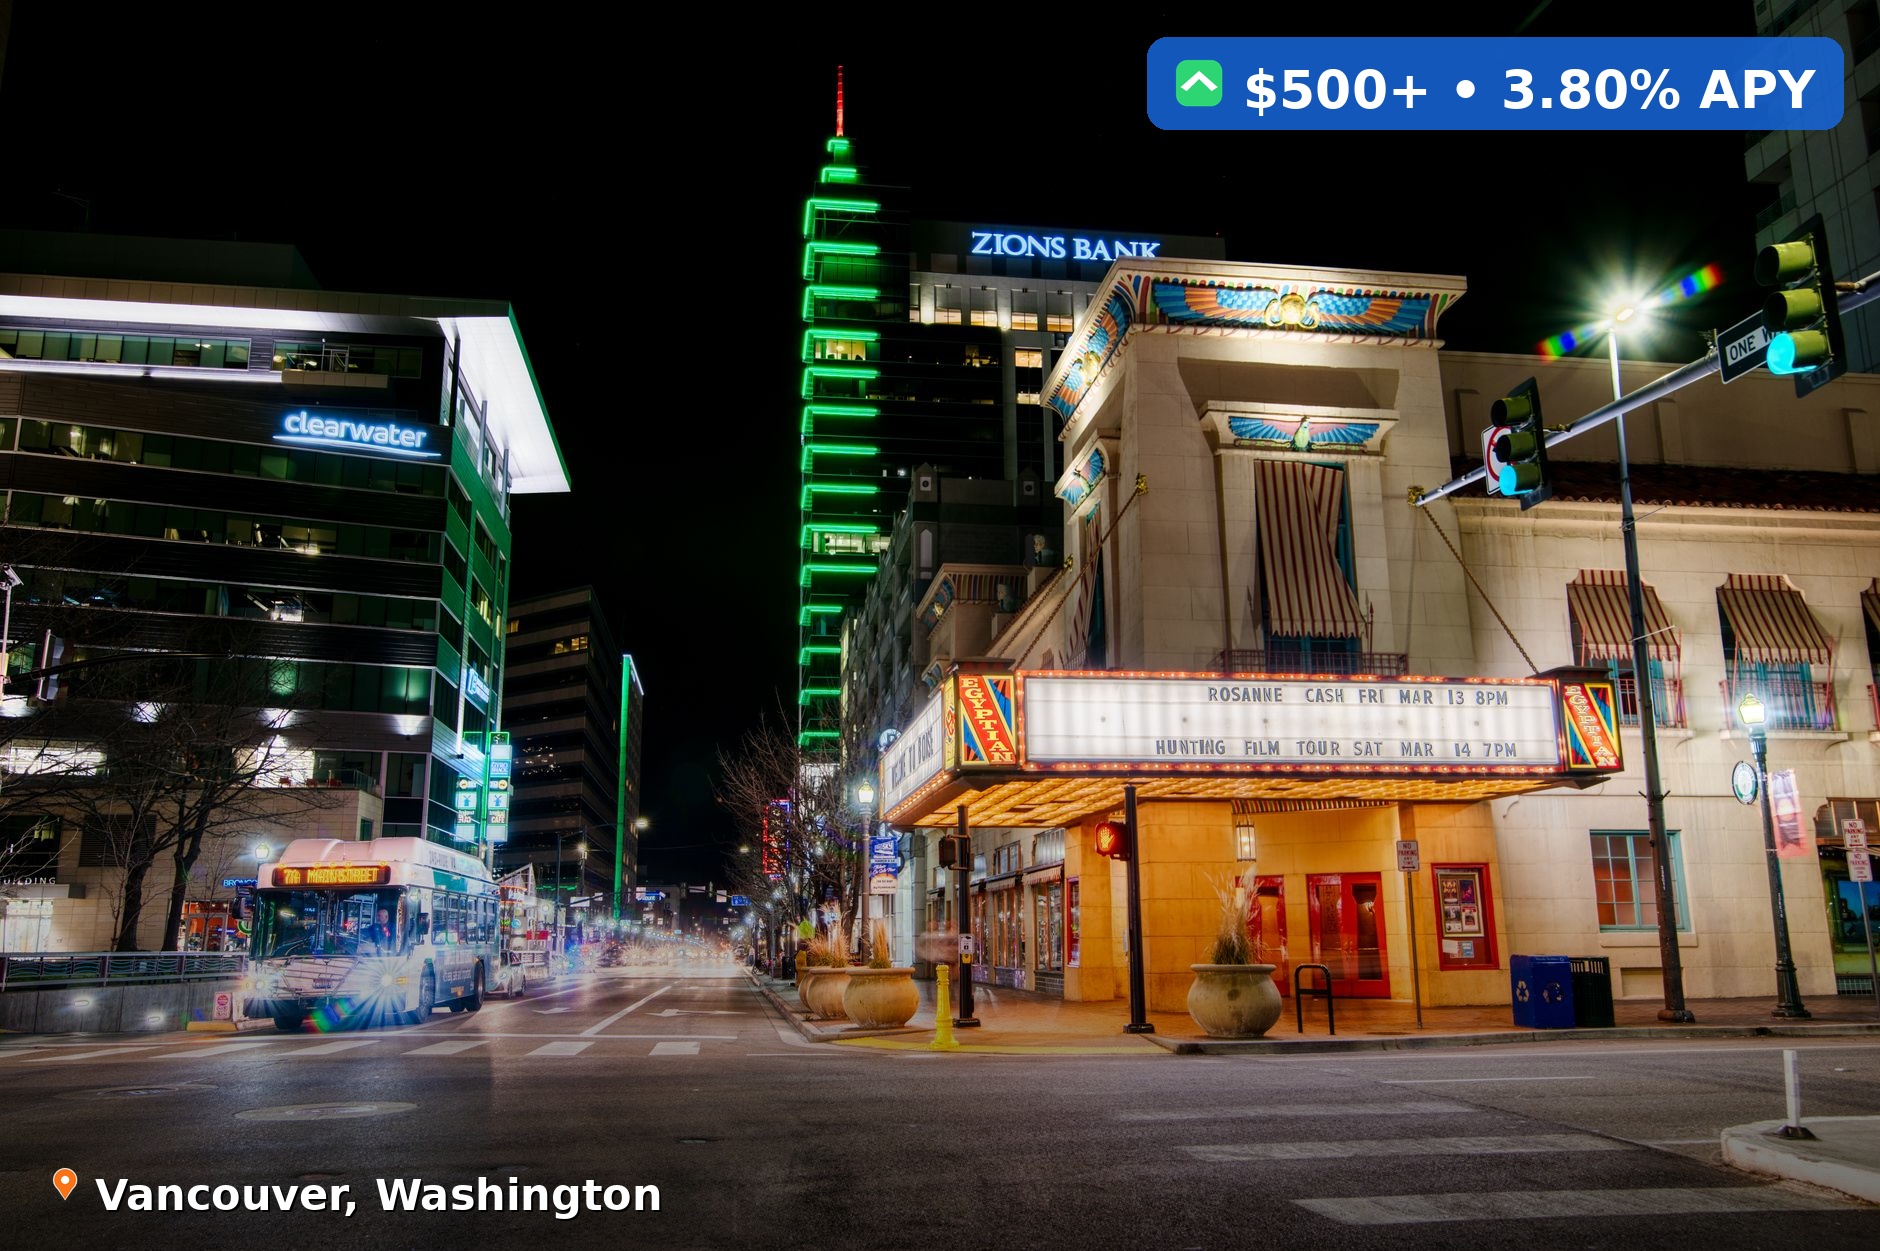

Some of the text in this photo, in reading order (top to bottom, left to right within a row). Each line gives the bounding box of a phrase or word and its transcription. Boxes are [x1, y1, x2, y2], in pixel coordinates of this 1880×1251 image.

[971, 231, 1161, 261] ZIONS BANK
[1729, 334, 1756, 361] ONE
[283, 410, 428, 448] clearwater
[1208, 686, 1509, 706] ROSANNE CASH FRI MAR 13 8PM
[961, 678, 1014, 762] EGYPTIAN
[1564, 685, 1618, 767] EGYPTIAN
[1156, 739, 1518, 758] HUNTING FILM TOUR SAT MAR 14 7PM
